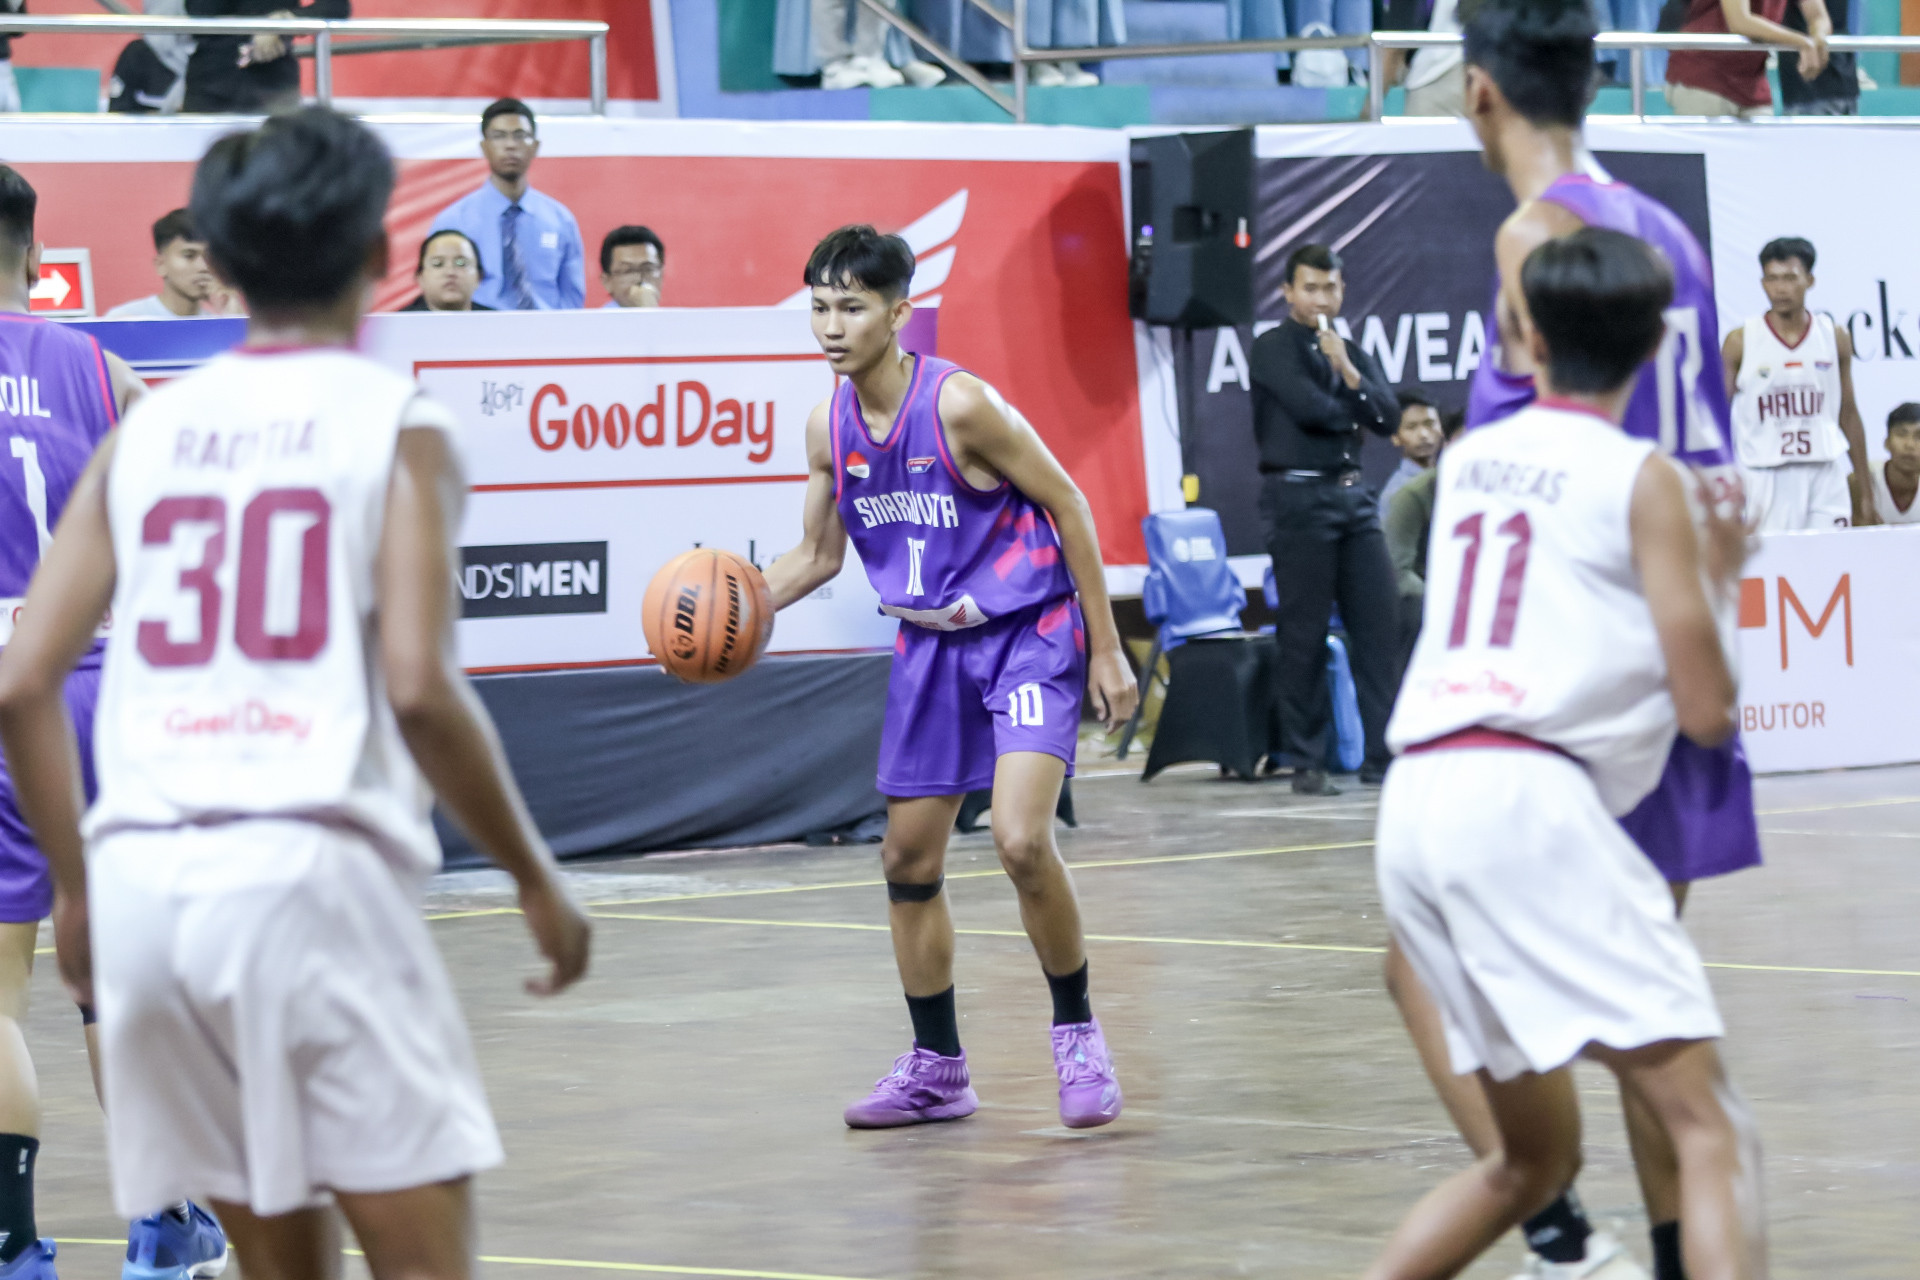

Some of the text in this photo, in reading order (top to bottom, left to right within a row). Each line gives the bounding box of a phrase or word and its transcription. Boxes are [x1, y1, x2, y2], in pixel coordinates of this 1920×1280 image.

[1781, 431, 1811, 456] 25
[136, 487, 333, 669] 30
[1447, 511, 1532, 649] 11
[675, 584, 702, 635] DBL
[1008, 683, 1043, 727] 10
